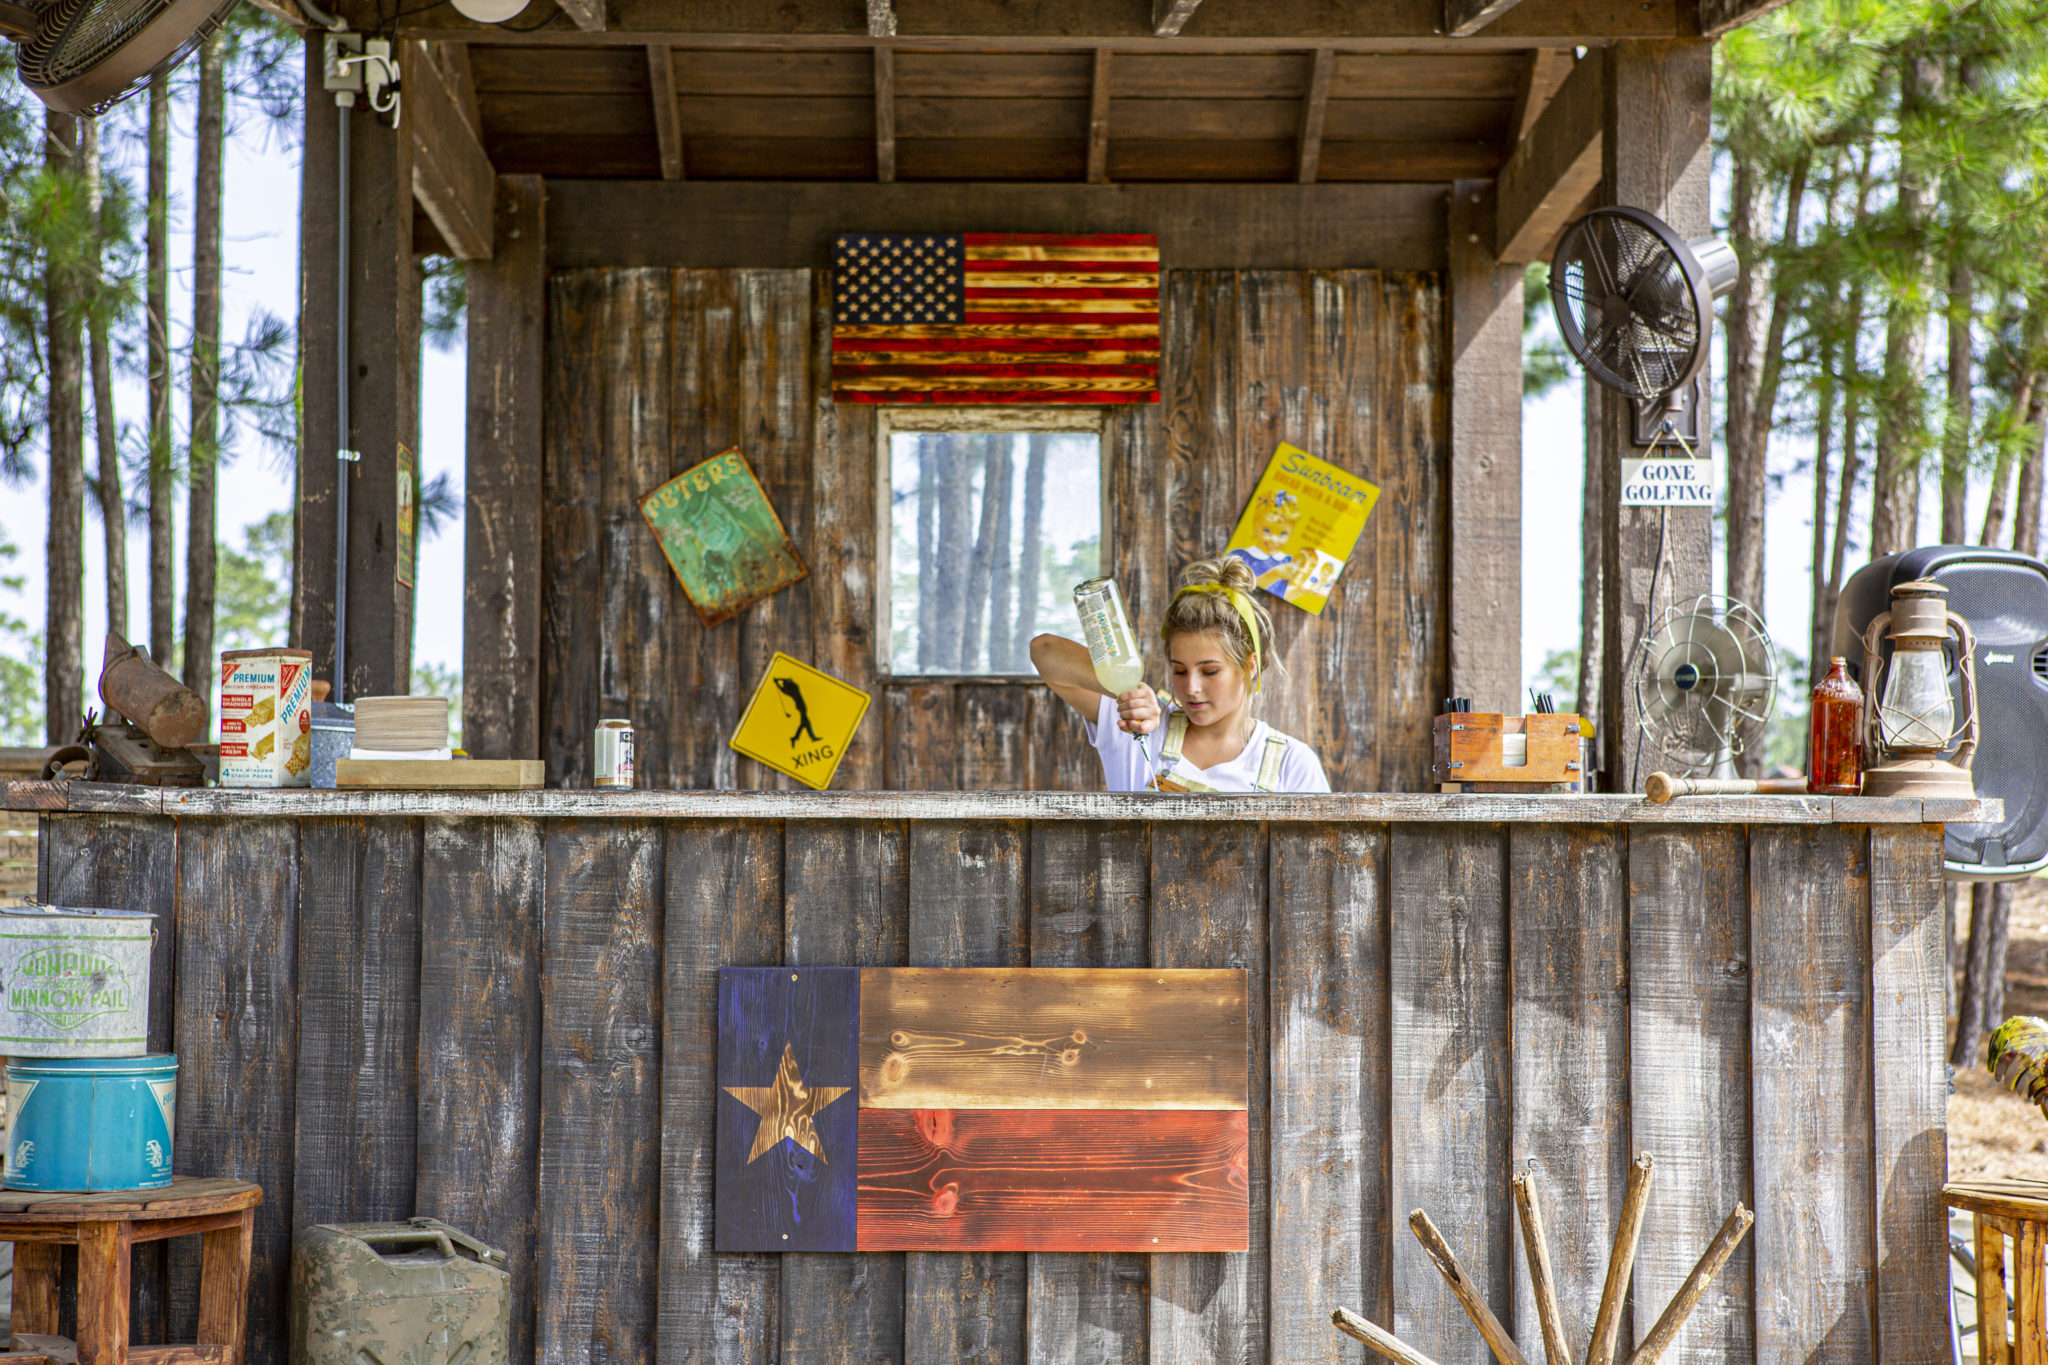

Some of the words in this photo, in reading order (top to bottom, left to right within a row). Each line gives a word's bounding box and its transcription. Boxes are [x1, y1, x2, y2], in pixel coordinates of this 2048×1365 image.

[1281, 454, 1367, 504] Sunbeam
[1642, 465, 1695, 480] GONE
[643, 453, 742, 518] PETERS
[1626, 485, 1711, 500] GOLFING
[233, 672, 275, 683] PREMIUM
[281, 665, 312, 724] PREMIUM
[792, 745, 834, 769] XING
[222, 768, 230, 776] 4
[11, 988, 86, 1008] MINNOW
[90, 988, 125, 1008] PAIL
